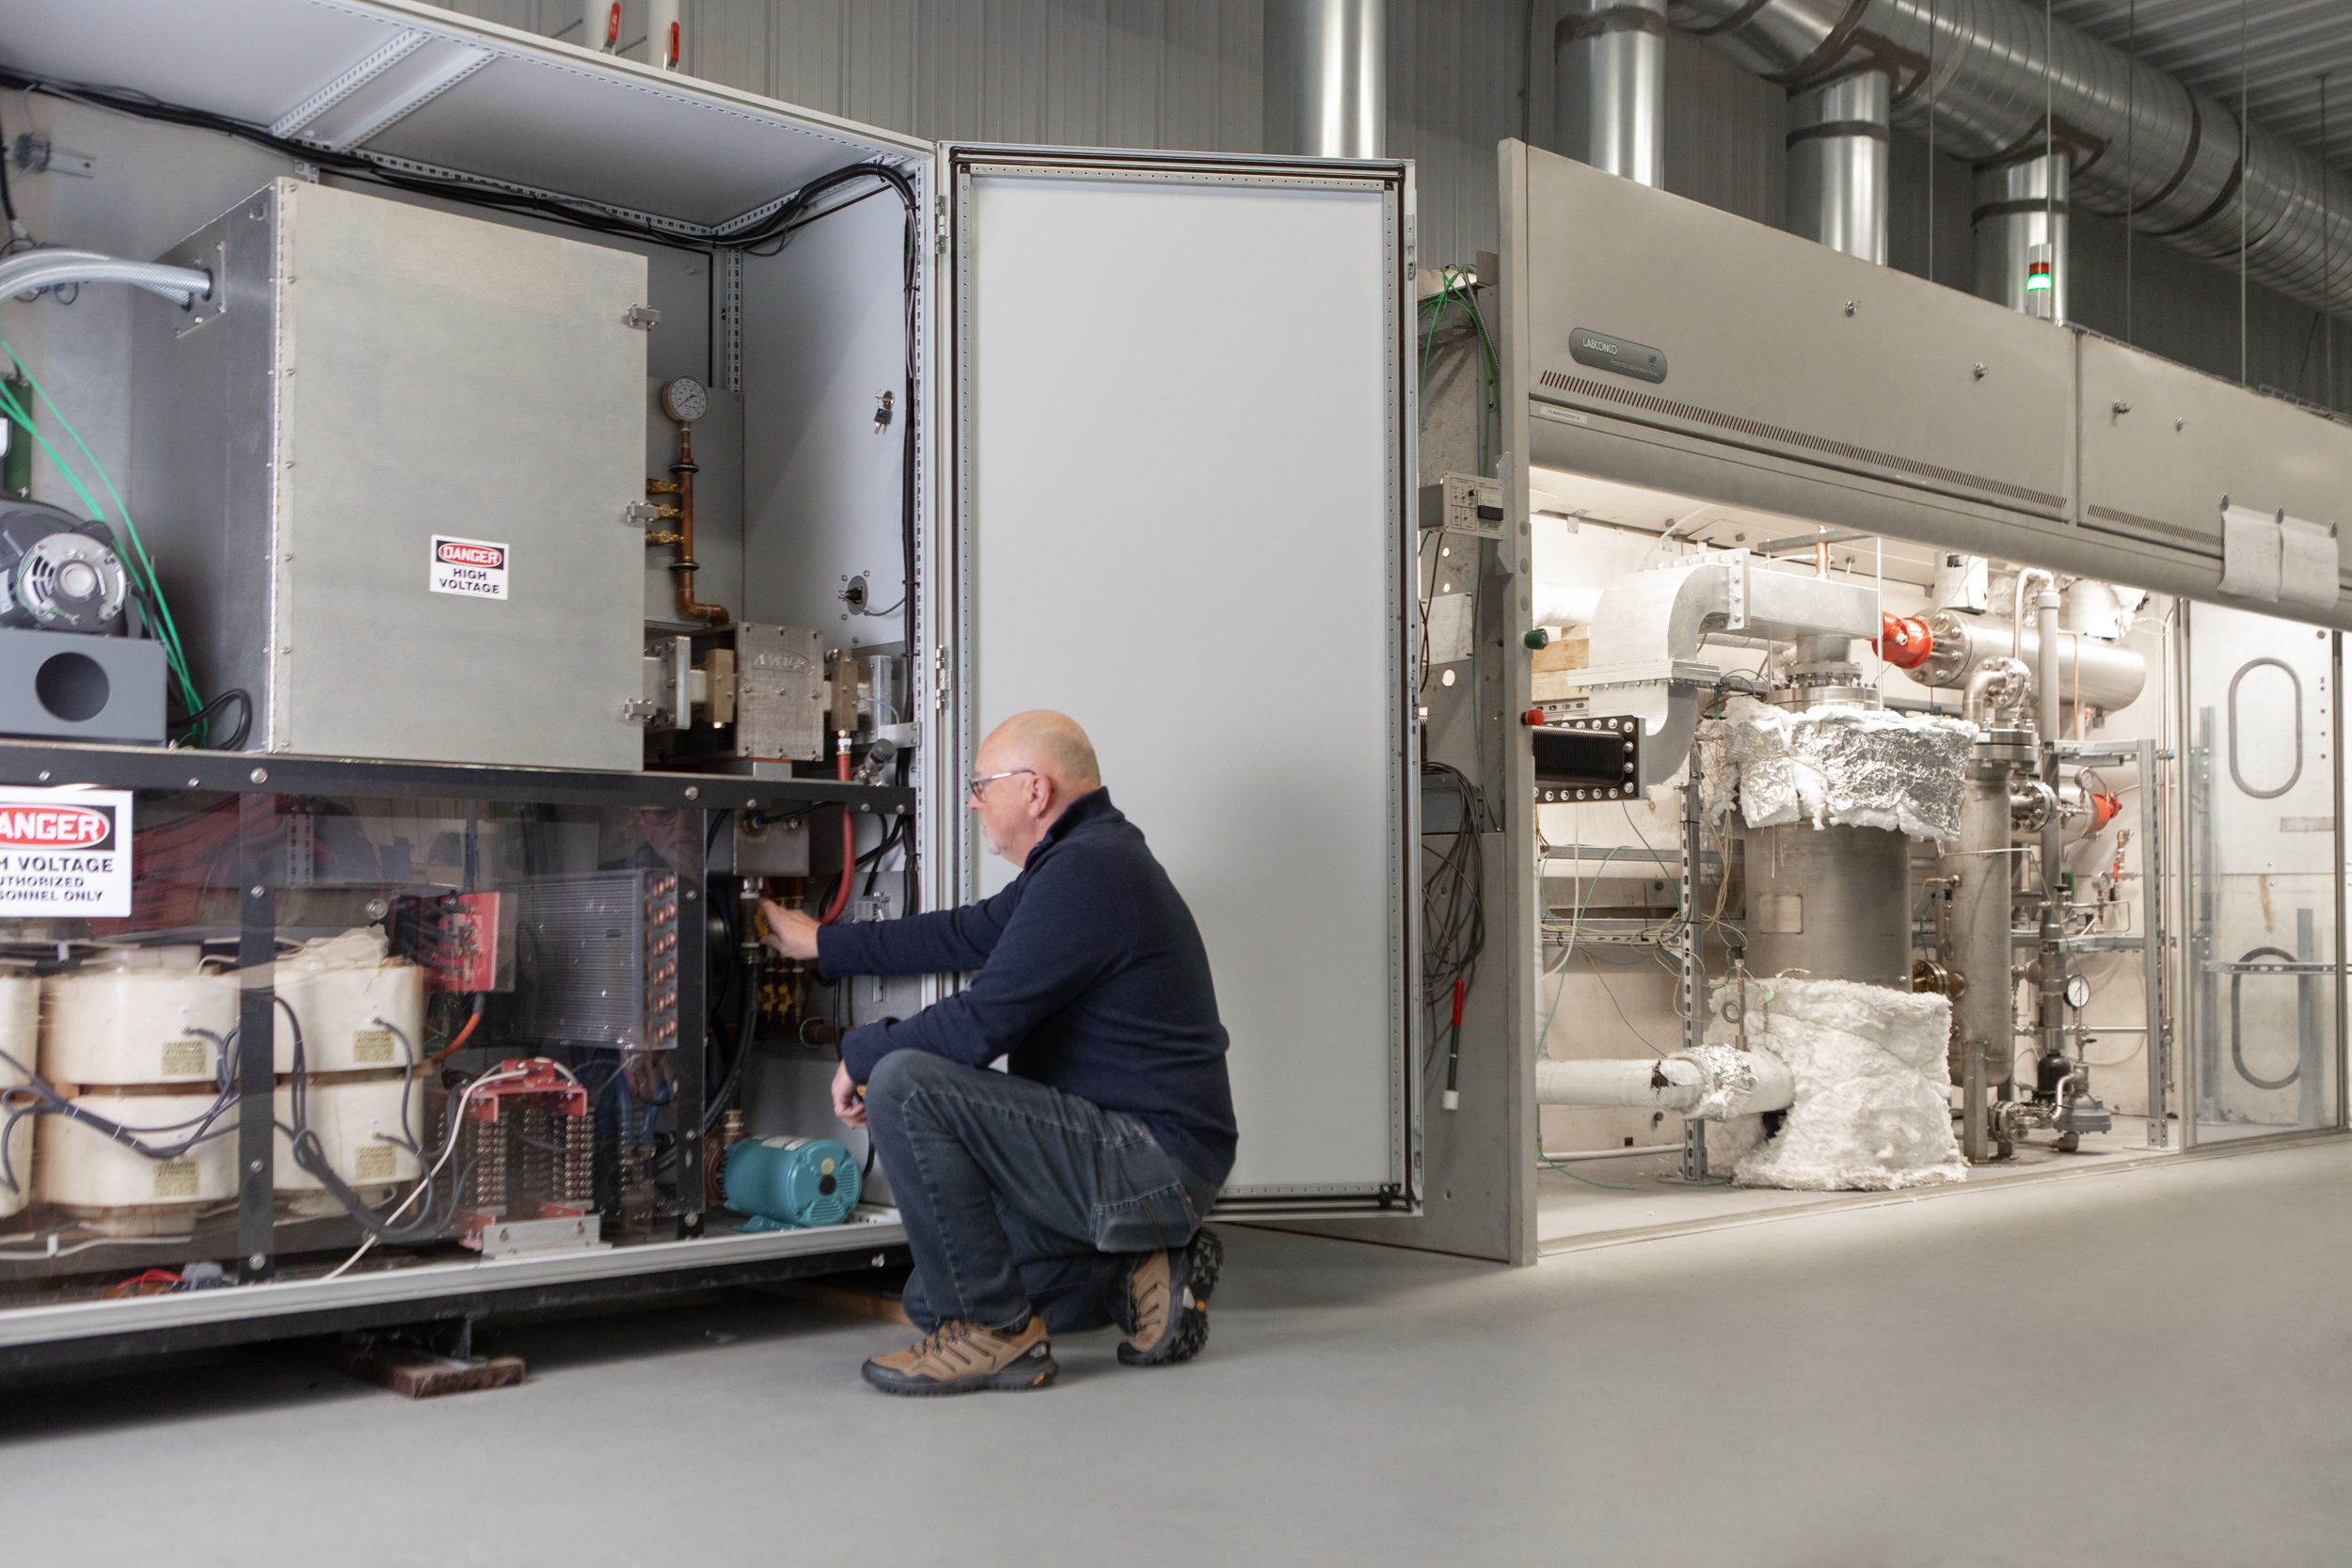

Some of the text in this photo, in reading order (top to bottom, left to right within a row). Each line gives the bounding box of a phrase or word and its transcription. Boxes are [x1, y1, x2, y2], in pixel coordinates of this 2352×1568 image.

[1582, 337, 1618, 355] LABCONCO
[1628, 363, 1647, 374] Laboratory
[443, 546, 498, 564] DANGER
[453, 568, 486, 580] HIGH
[439, 578, 500, 594] VOLTAGE
[0, 811, 101, 842] ANGER
[18, 856, 114, 873] VOLTAGE
[64, 890, 103, 902] ONLY
